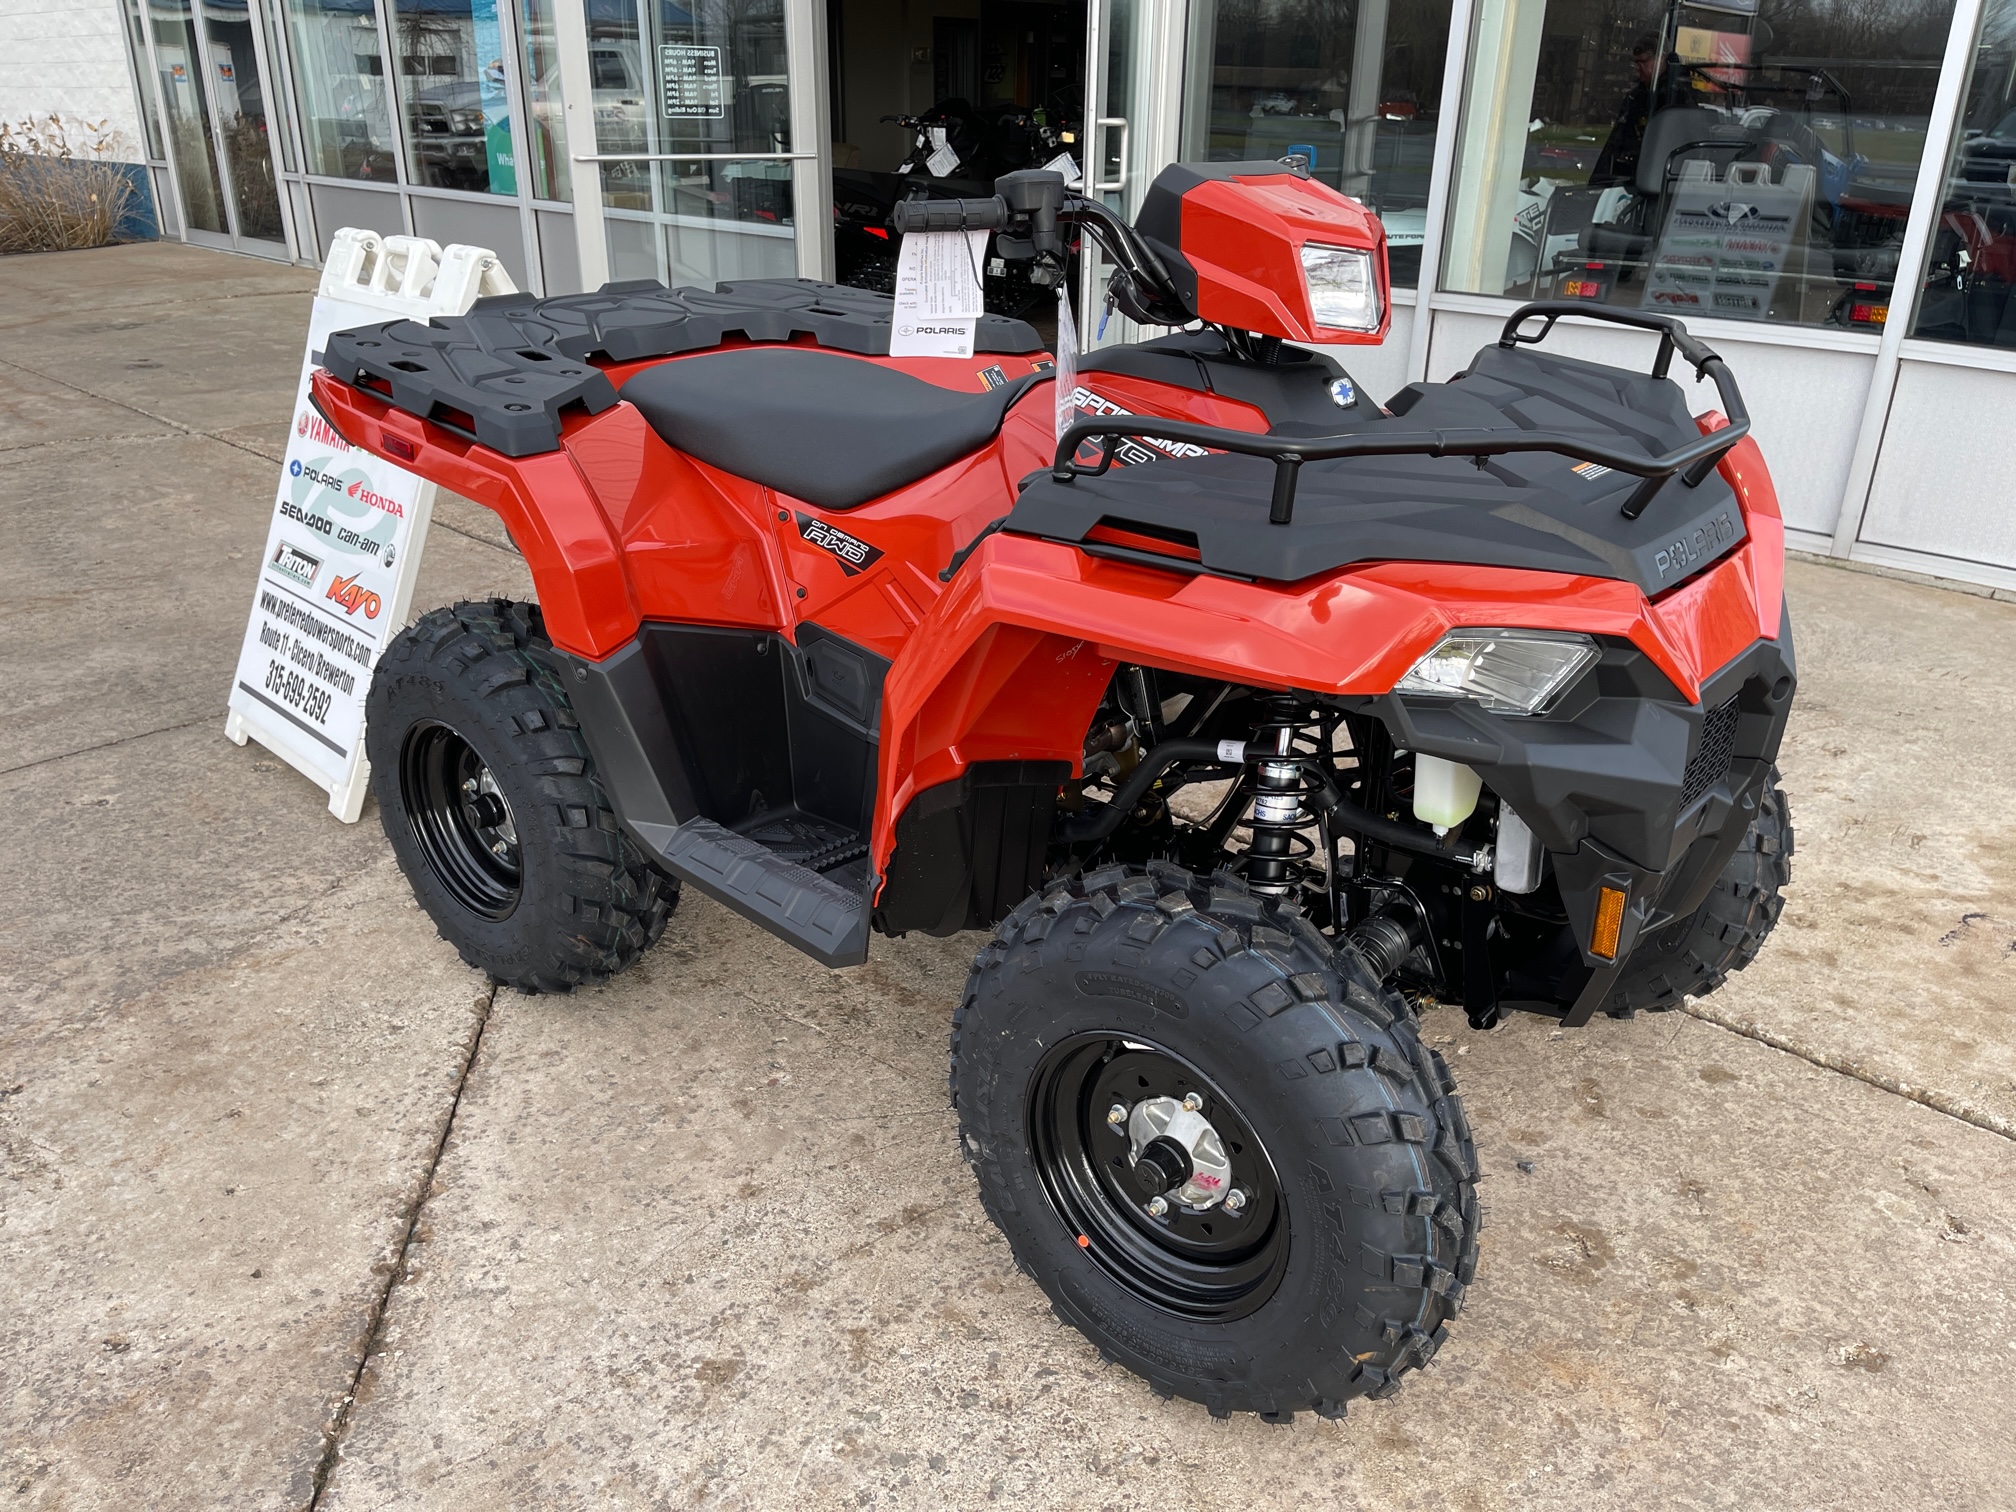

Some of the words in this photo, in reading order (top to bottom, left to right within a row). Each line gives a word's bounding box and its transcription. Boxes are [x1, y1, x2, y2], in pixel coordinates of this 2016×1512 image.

[916, 327, 966, 336] POLARIS
[303, 466, 343, 492] POLARIS
[360, 488, 405, 518] HONDA
[337, 527, 381, 556] can-am
[802, 526, 866, 564] AWD
[1654, 511, 1735, 579] POLARIS
[277, 545, 317, 580] TRITON
[325, 570, 382, 620] KAYO
[259, 588, 372, 669] www.preferredpowersports.com
[259, 620, 282, 652] Route
[280, 632, 290, 657] 11
[291, 638, 355, 697] Cicero/Brewerton
[265, 658, 332, 726] 315-699-2592
[1108, 986, 1154, 1003] TUBELESS
[1306, 1158, 1347, 1329] AT489
